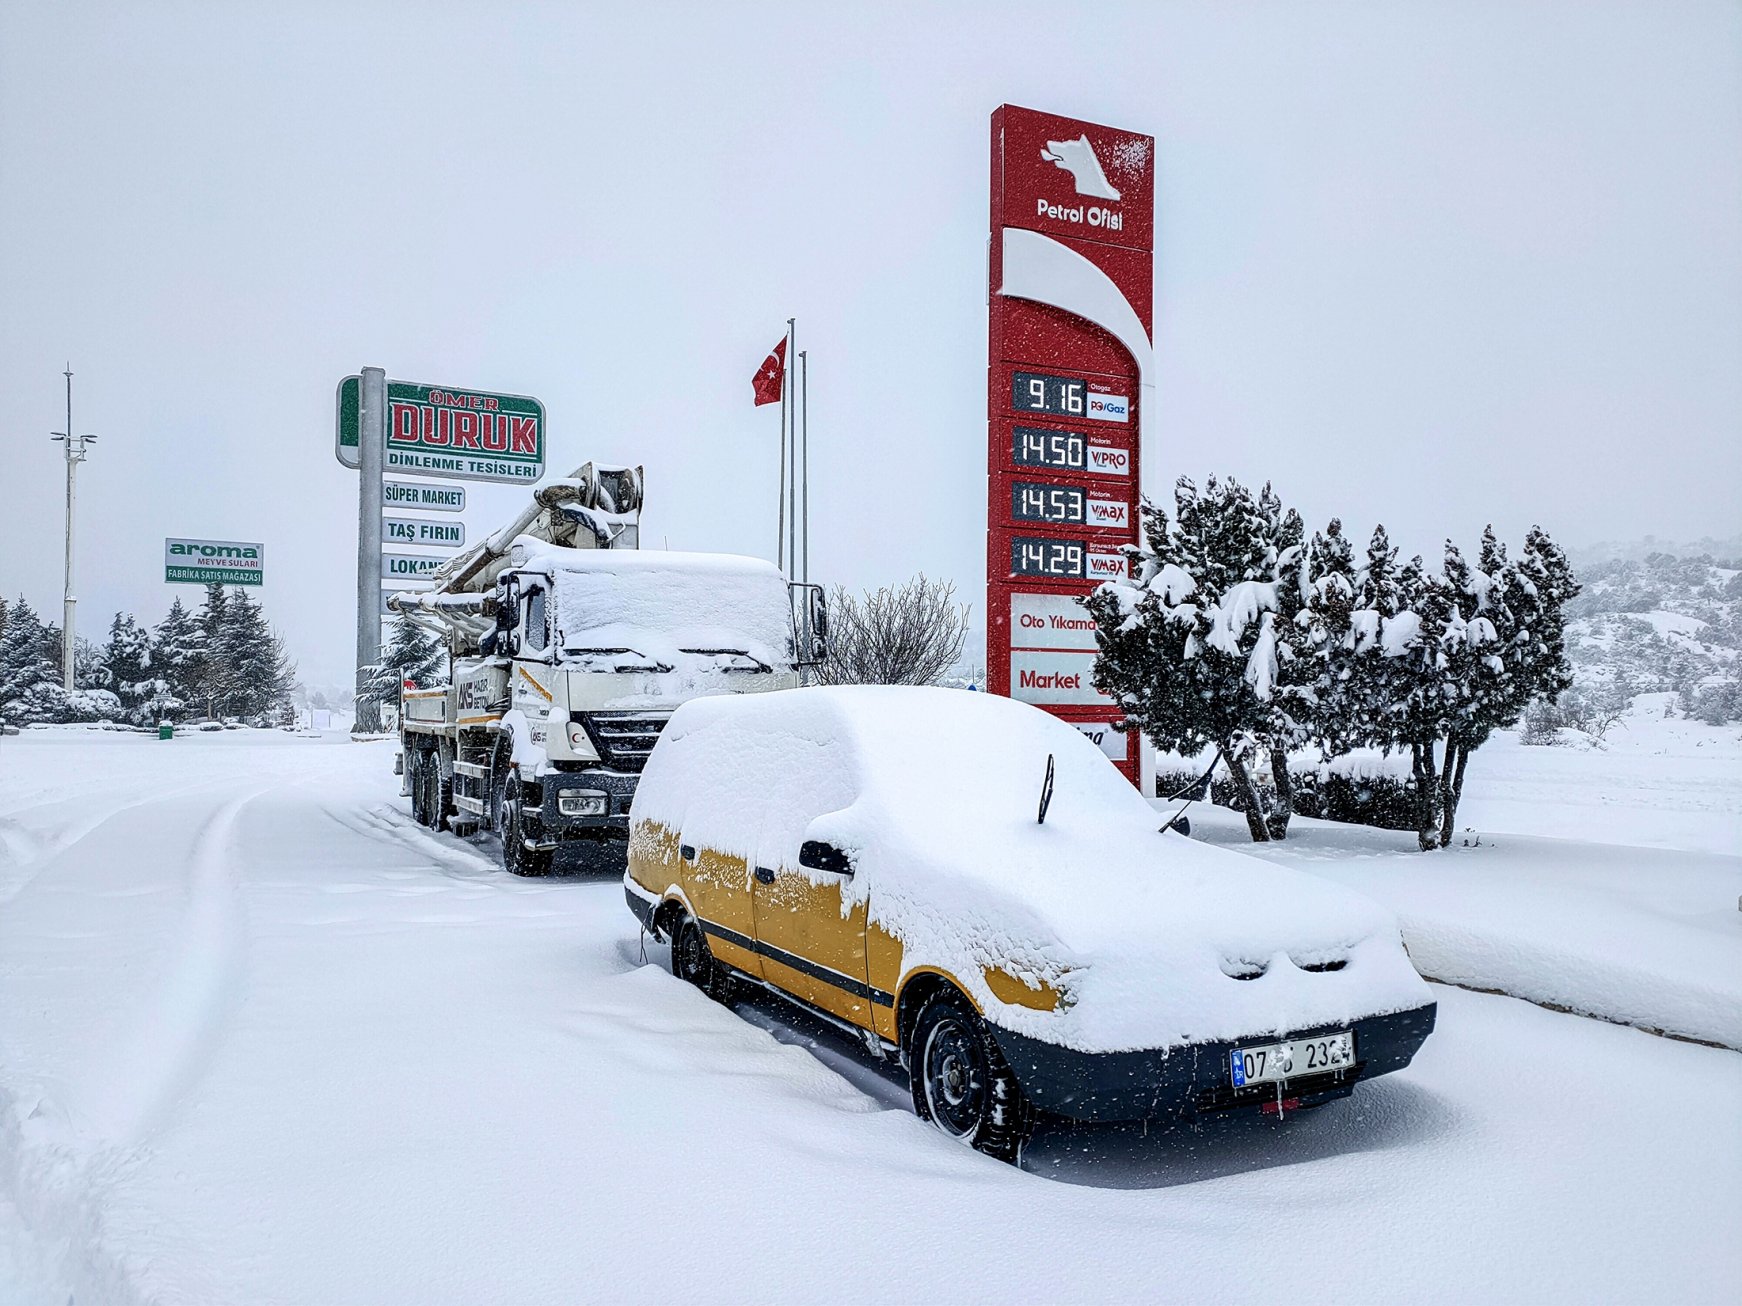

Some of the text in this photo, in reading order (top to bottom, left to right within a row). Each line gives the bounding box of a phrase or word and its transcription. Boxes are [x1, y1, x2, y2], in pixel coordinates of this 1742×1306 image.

[1037, 199, 1123, 231] Petrol Ofisi
[1029, 379, 1082, 413] 9.16
[1090, 383, 1111, 392] Otogaz
[429, 390, 500, 411] ÖMER
[391, 402, 537, 455] DURUK
[1023, 434, 1082, 466] 14.50
[389, 451, 537, 477] DİNLENME TESİSLERİ
[385, 484, 463, 506] SÜPER MARKET
[1022, 489, 1082, 520] 14.53
[388, 522, 460, 541] TAŞ FIRIN
[169, 543, 258, 559] aroma
[1022, 544, 1082, 574] 14.29
[197, 558, 258, 568] MEYVE SULARI
[390, 559, 444, 574] LOKAN
[167, 568, 200, 580] FABRİKA
[222, 571, 261, 583] MAĞAZASI
[1020, 614, 1096, 631] Oto Yıkama
[1020, 670, 1080, 689] Market
[1244, 1051, 1267, 1079] 07
